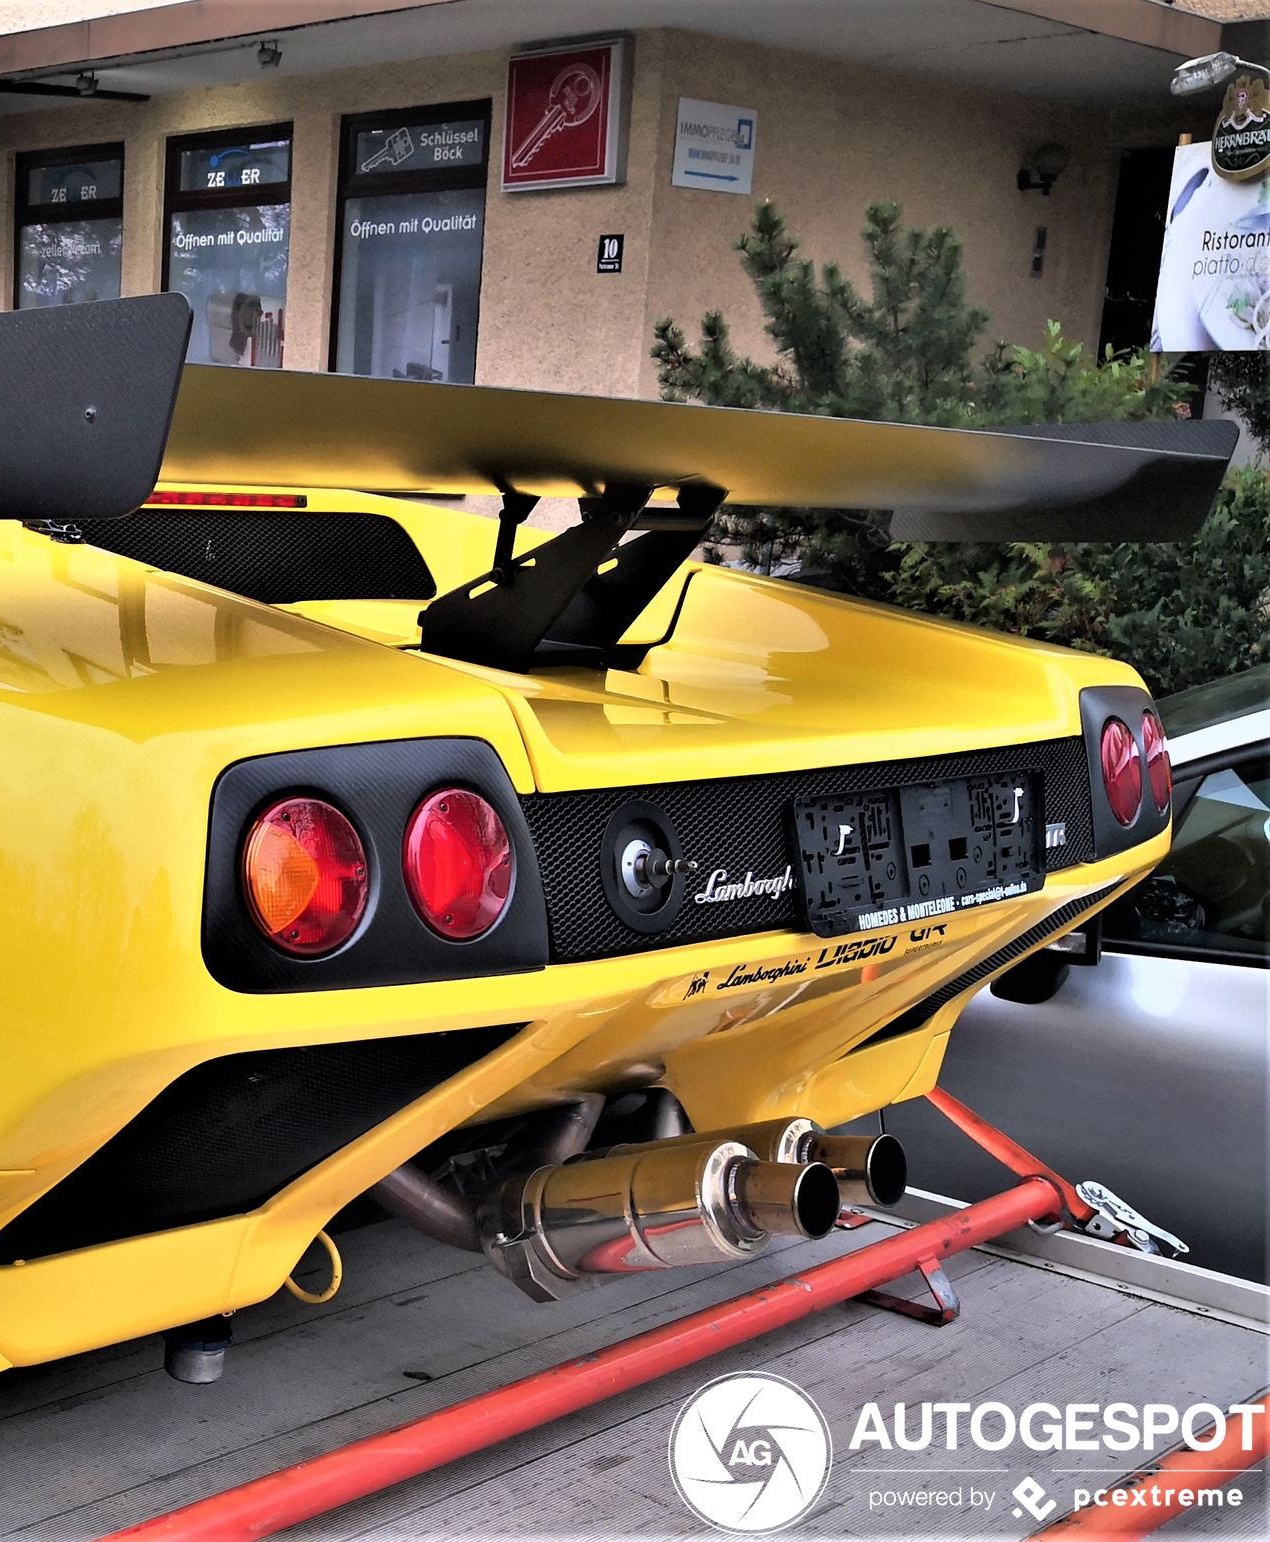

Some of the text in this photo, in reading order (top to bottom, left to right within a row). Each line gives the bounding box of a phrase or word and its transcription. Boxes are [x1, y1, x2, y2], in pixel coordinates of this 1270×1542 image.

[420, 128, 478, 147] Schlüssel
[434, 146, 463, 161] Böck
[350, 214, 477, 239] Öffnen mit Qualität
[176, 228, 284, 250] Öffnen mit Qualität
[603, 238, 619, 259] 10
[694, 864, 794, 905] Lamborgh
[858, 911, 899, 931] HOMEDES
[900, 908, 907, 922] &
[907, 896, 956, 921] MONTELEONE
[716, 956, 811, 990] Lamborghini
